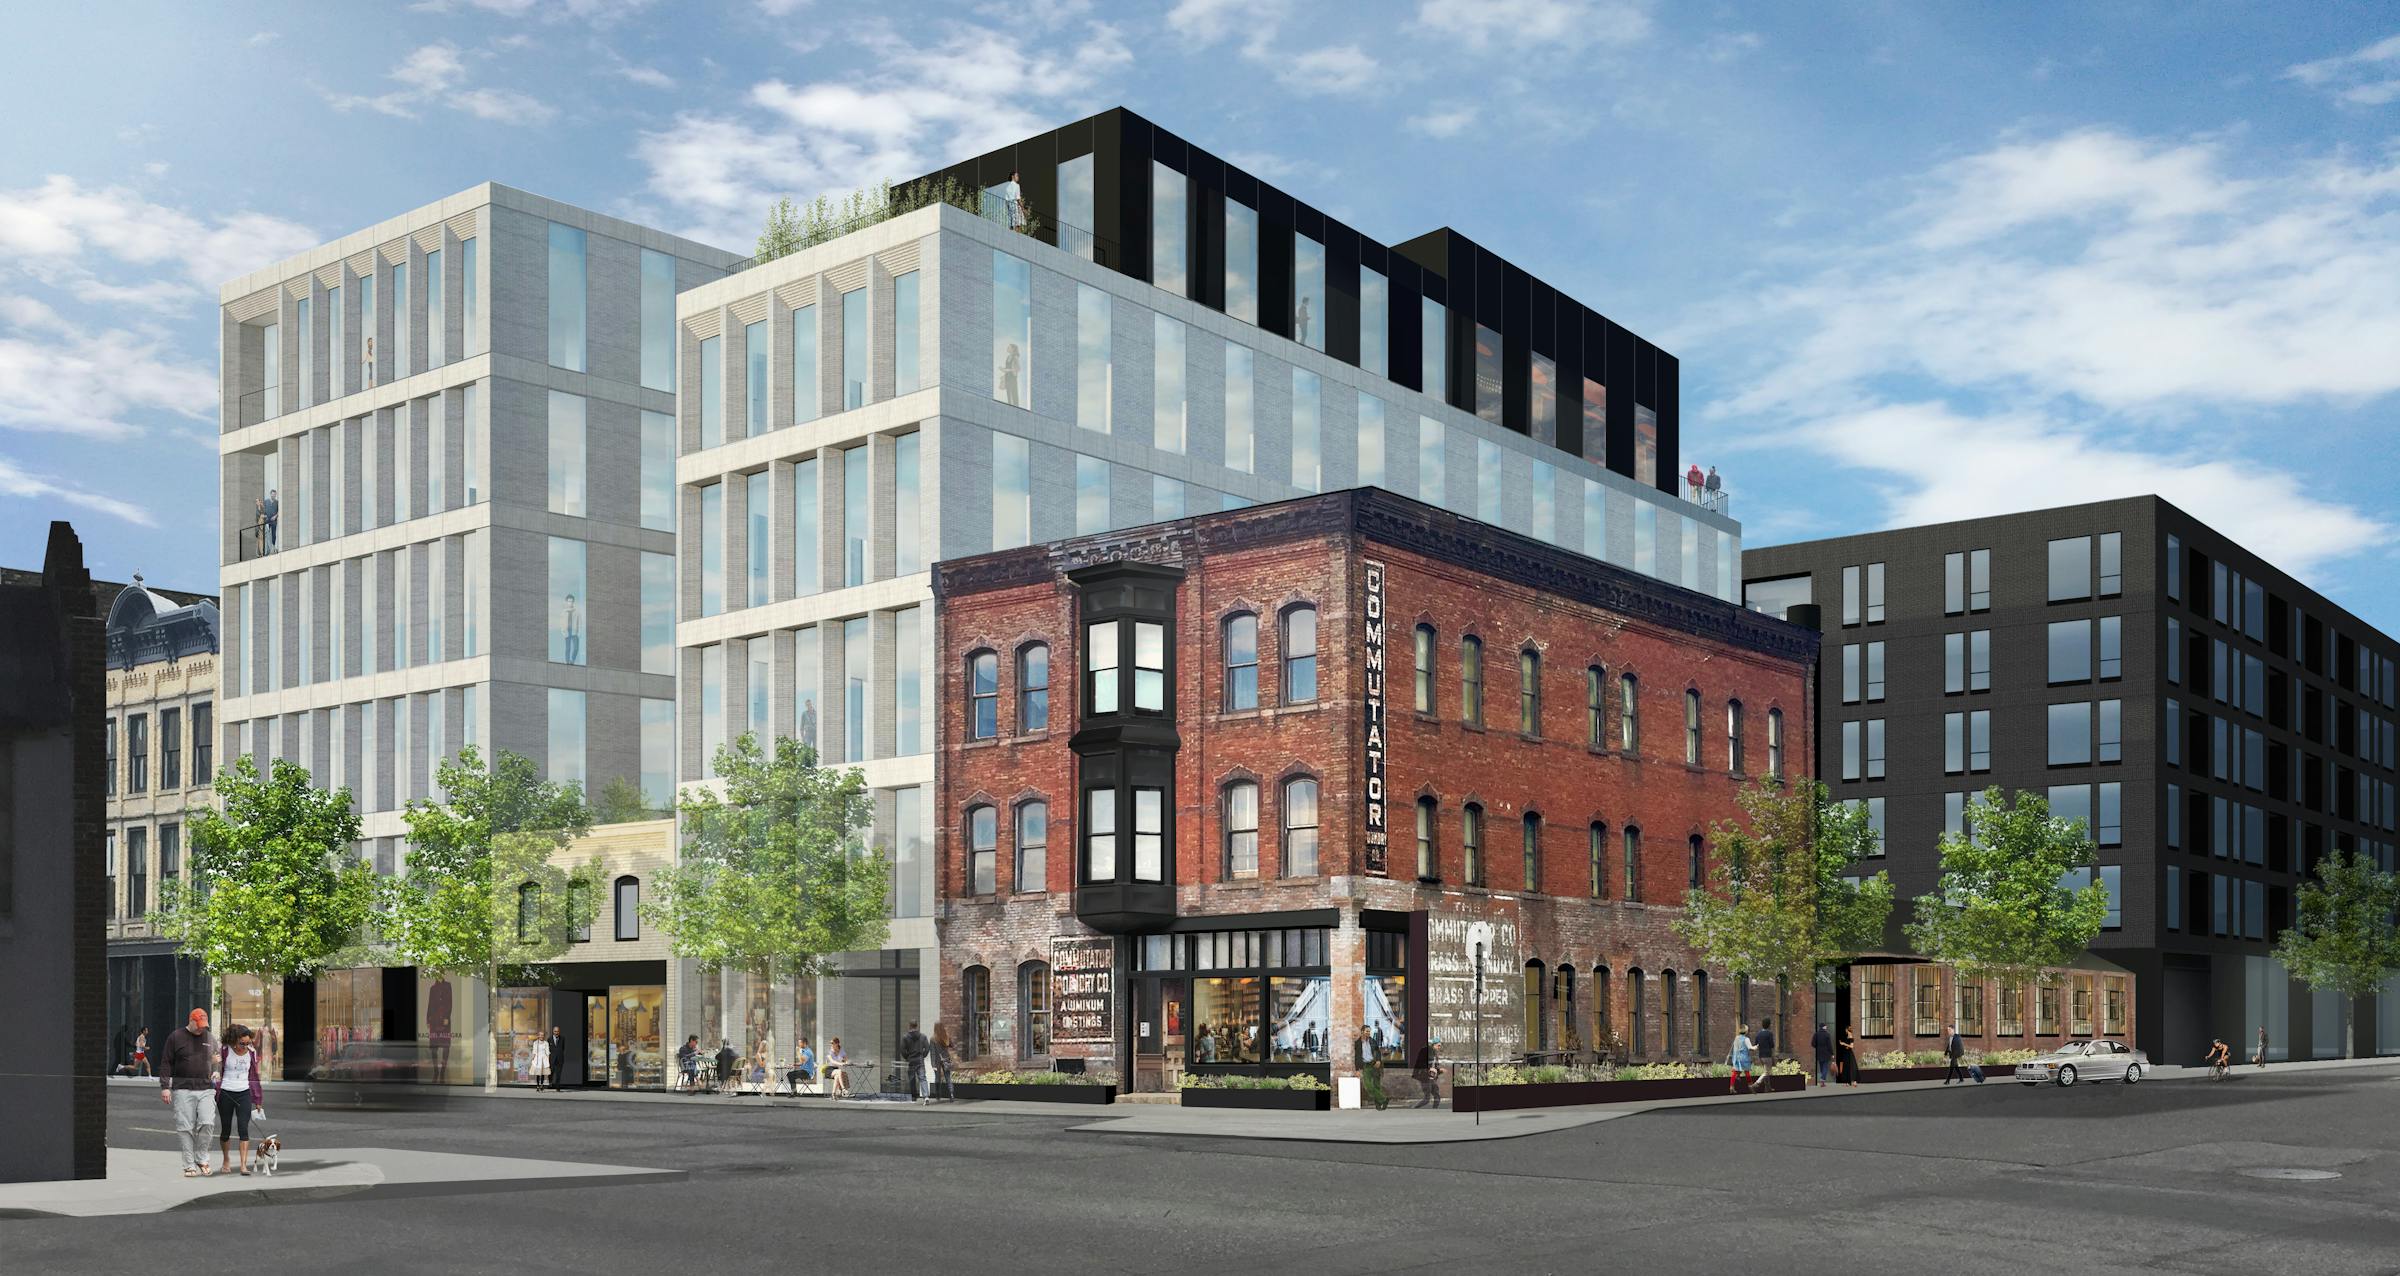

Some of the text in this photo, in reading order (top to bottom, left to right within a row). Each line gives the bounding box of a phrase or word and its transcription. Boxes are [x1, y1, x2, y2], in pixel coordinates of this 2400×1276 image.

[1365, 569, 1383, 826] COMMUTATOR
[1053, 973, 1096, 996] ONDRY
[1428, 987, 1464, 1005] BRASS
[1060, 999, 1105, 1012] ALUMINUM
[1428, 1025, 1471, 1043] LUMINUM
